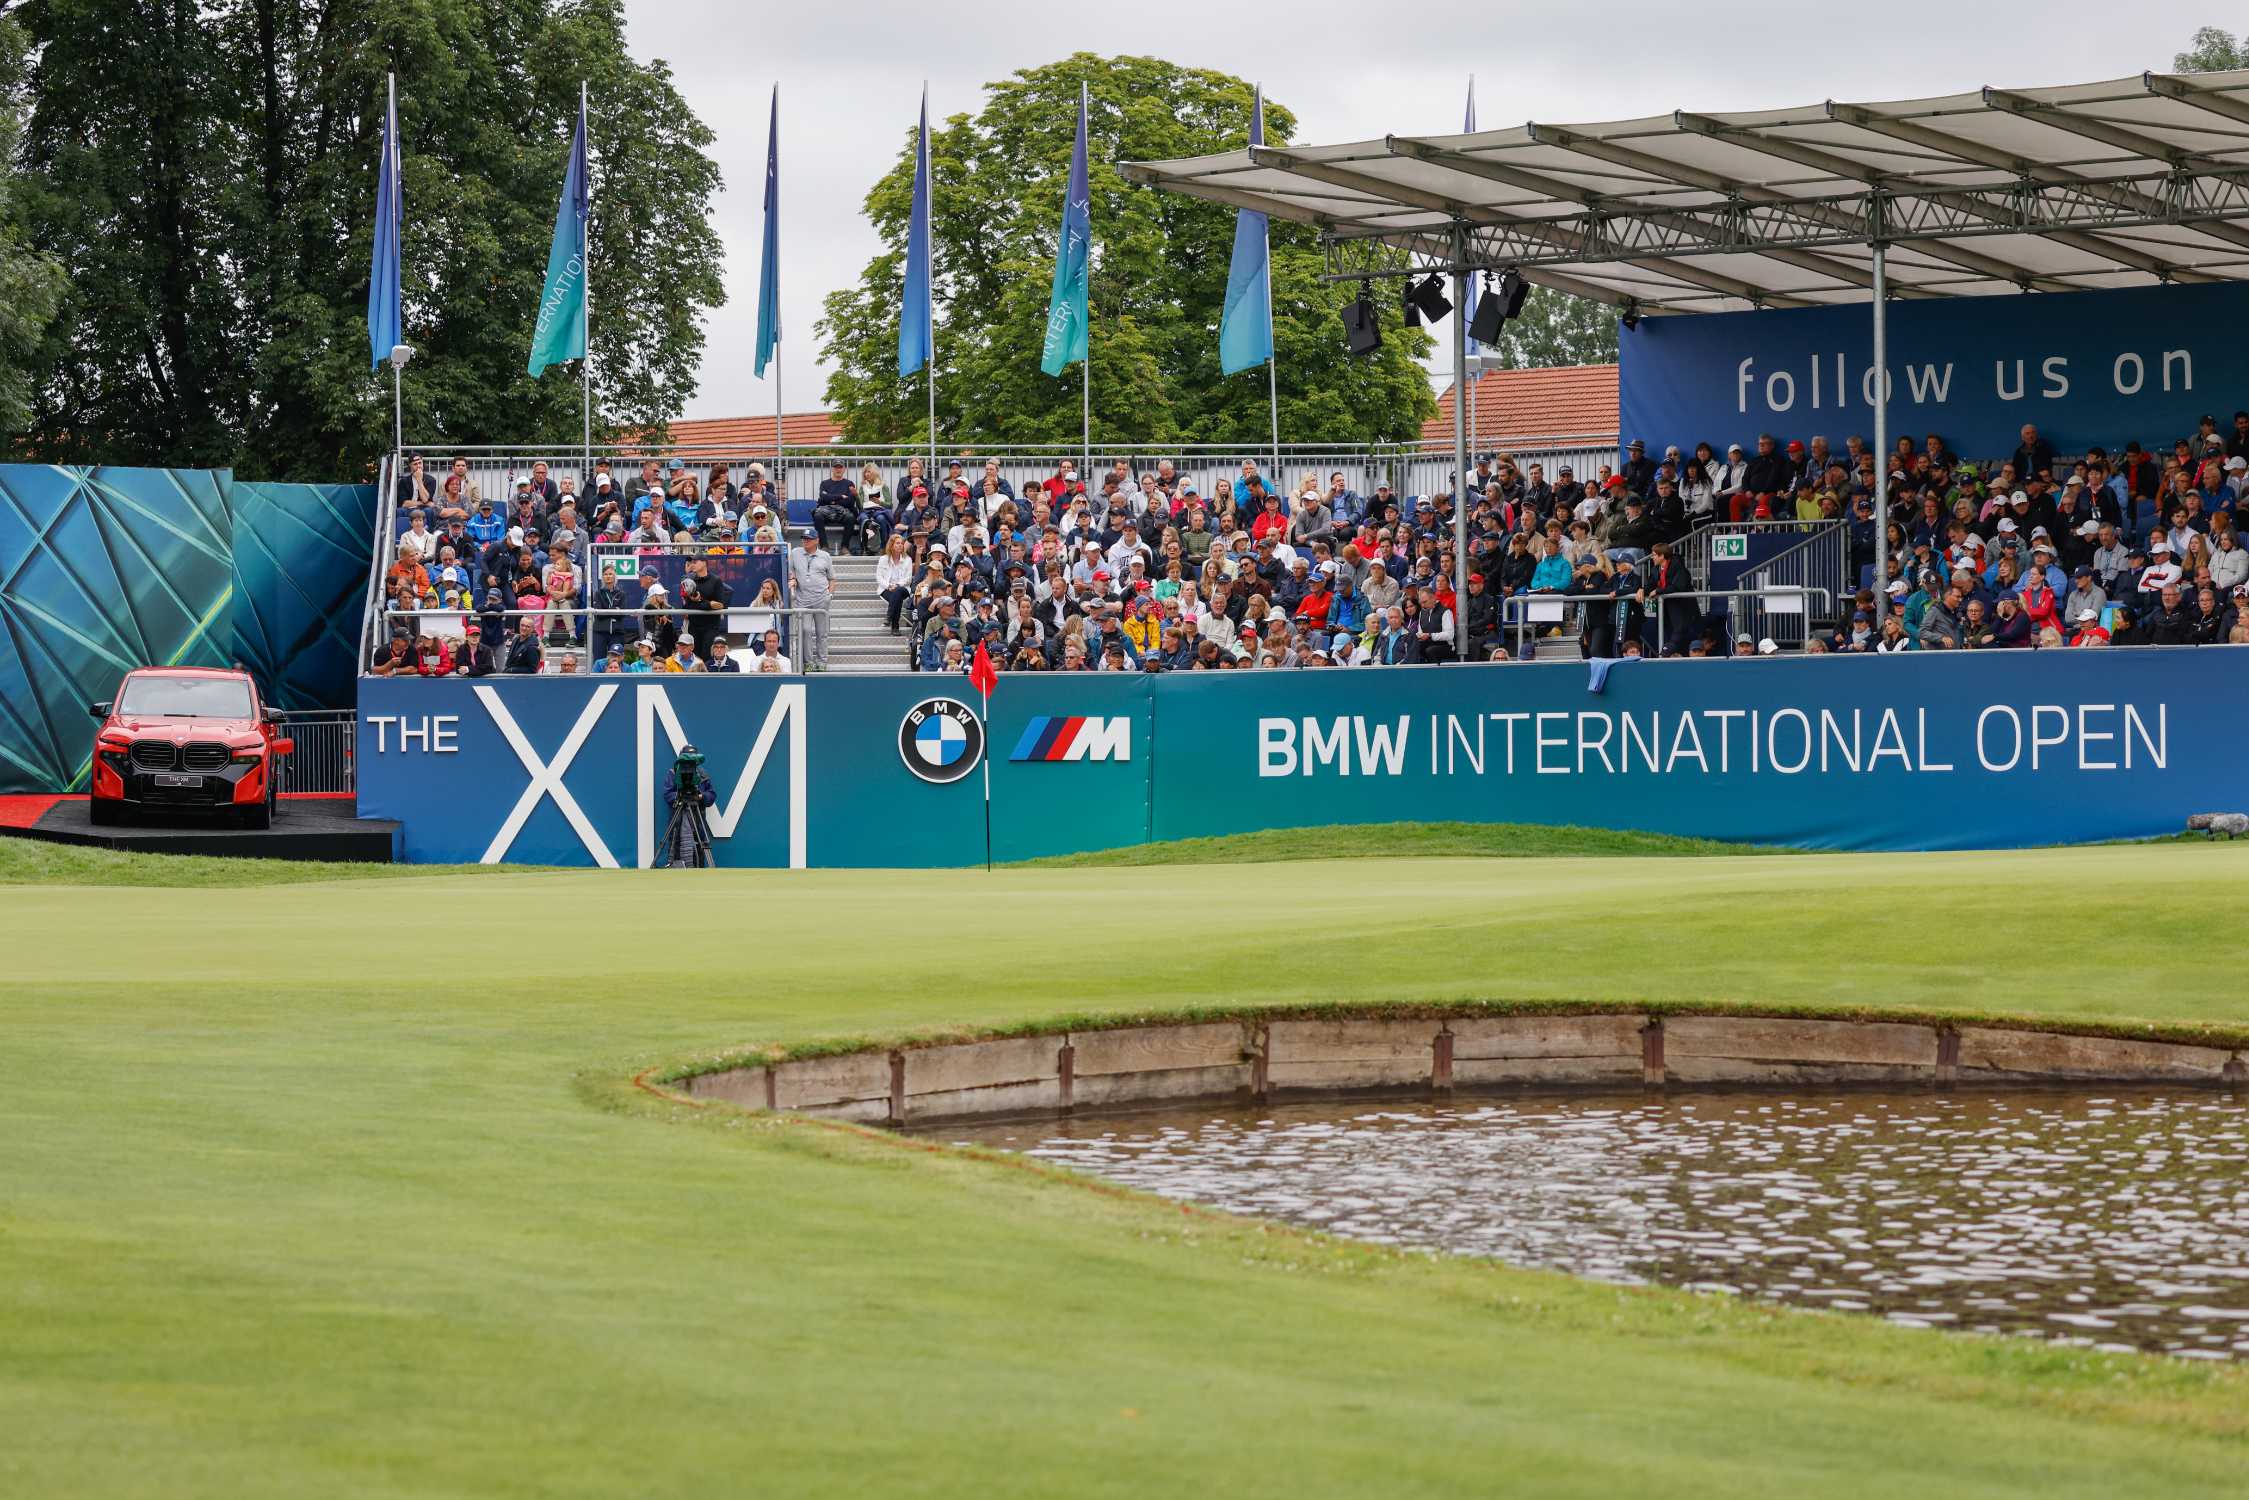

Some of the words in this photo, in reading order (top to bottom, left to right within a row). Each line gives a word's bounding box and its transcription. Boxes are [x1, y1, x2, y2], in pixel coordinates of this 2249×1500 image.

[1738, 352, 1954, 413] follow
[1996, 356, 2070, 401] us
[2113, 348, 2194, 396] on
[909, 701, 972, 726] BMW
[1258, 714, 1410, 777] BMW
[1431, 707, 1954, 776] INTERNATIONAL
[1976, 703, 2167, 773] OPEN
[366, 715, 459, 753] THE
[472, 683, 807, 869] XM
